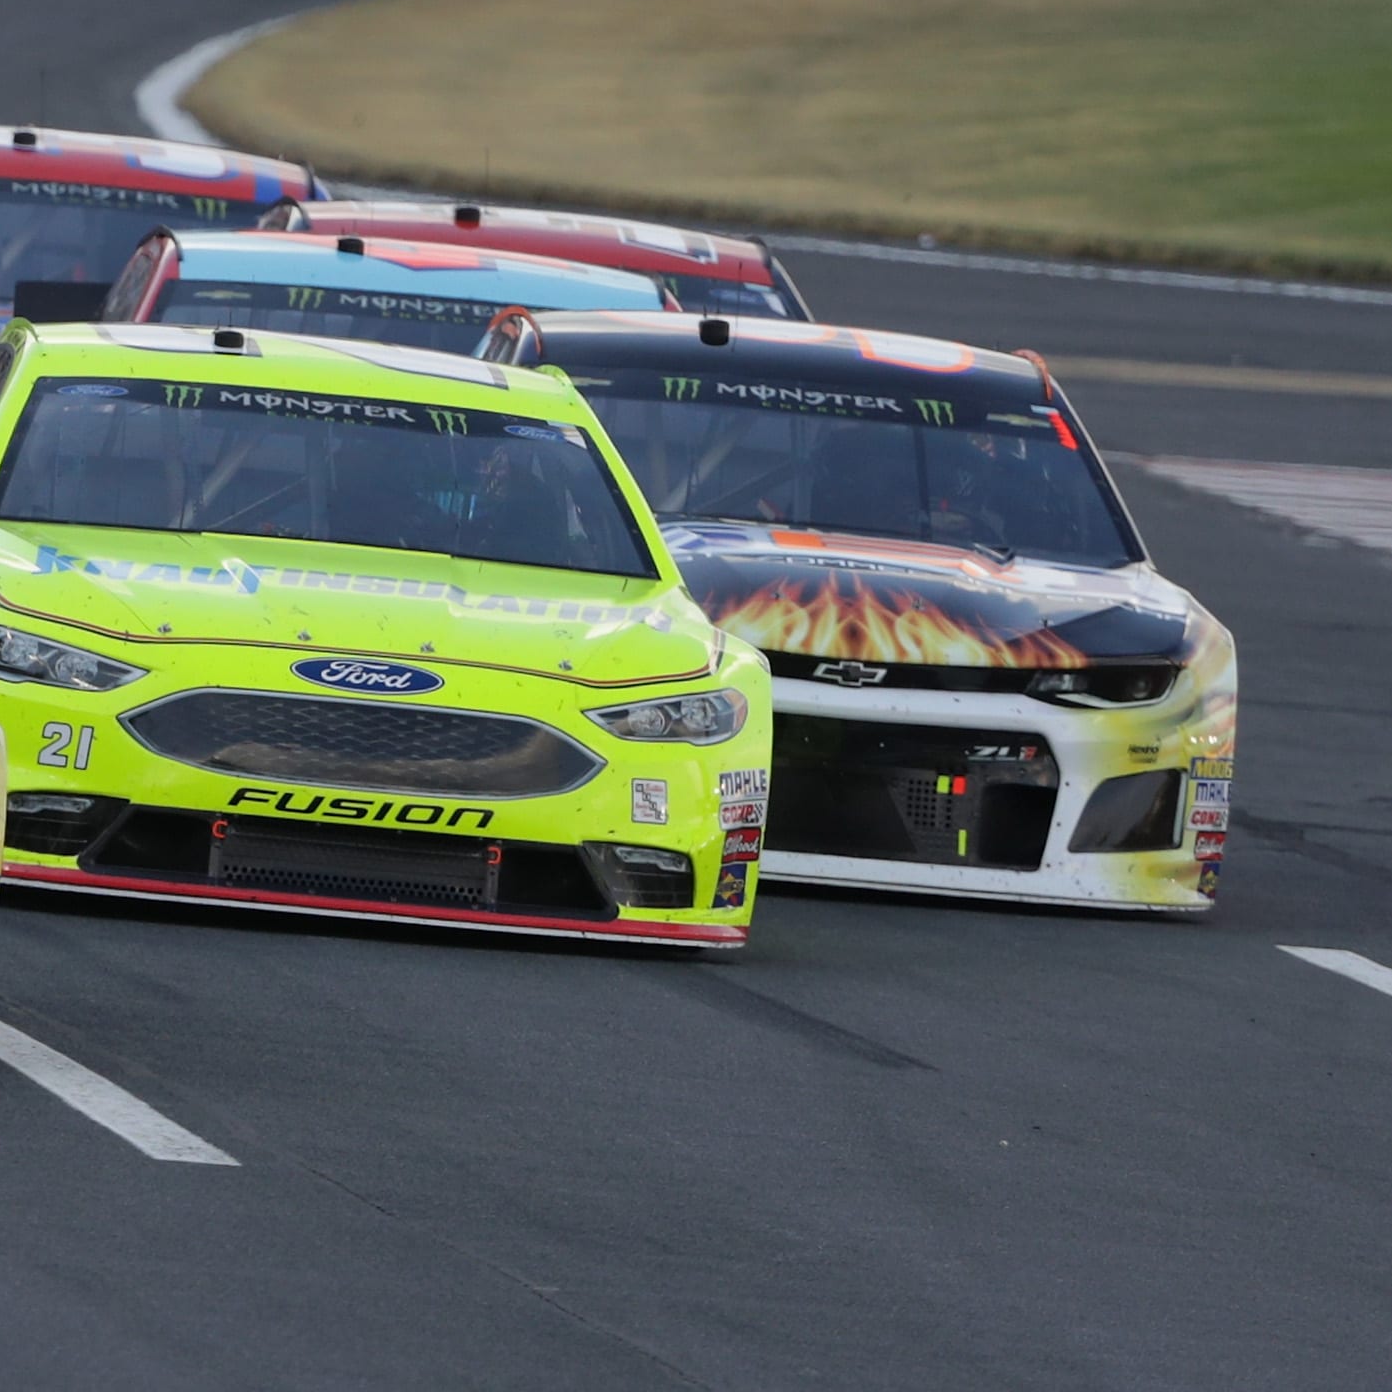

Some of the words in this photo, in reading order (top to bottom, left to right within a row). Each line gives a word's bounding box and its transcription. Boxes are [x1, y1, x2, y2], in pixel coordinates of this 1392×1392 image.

[339, 293, 503, 317] MONSTE
[219, 391, 416, 423] MONSTER
[716, 382, 903, 413] MONSTER
[319, 660, 414, 691] Ford
[37, 721, 95, 771] 21
[719, 767, 768, 796] MAHLE
[227, 786, 495, 829] FUSION
